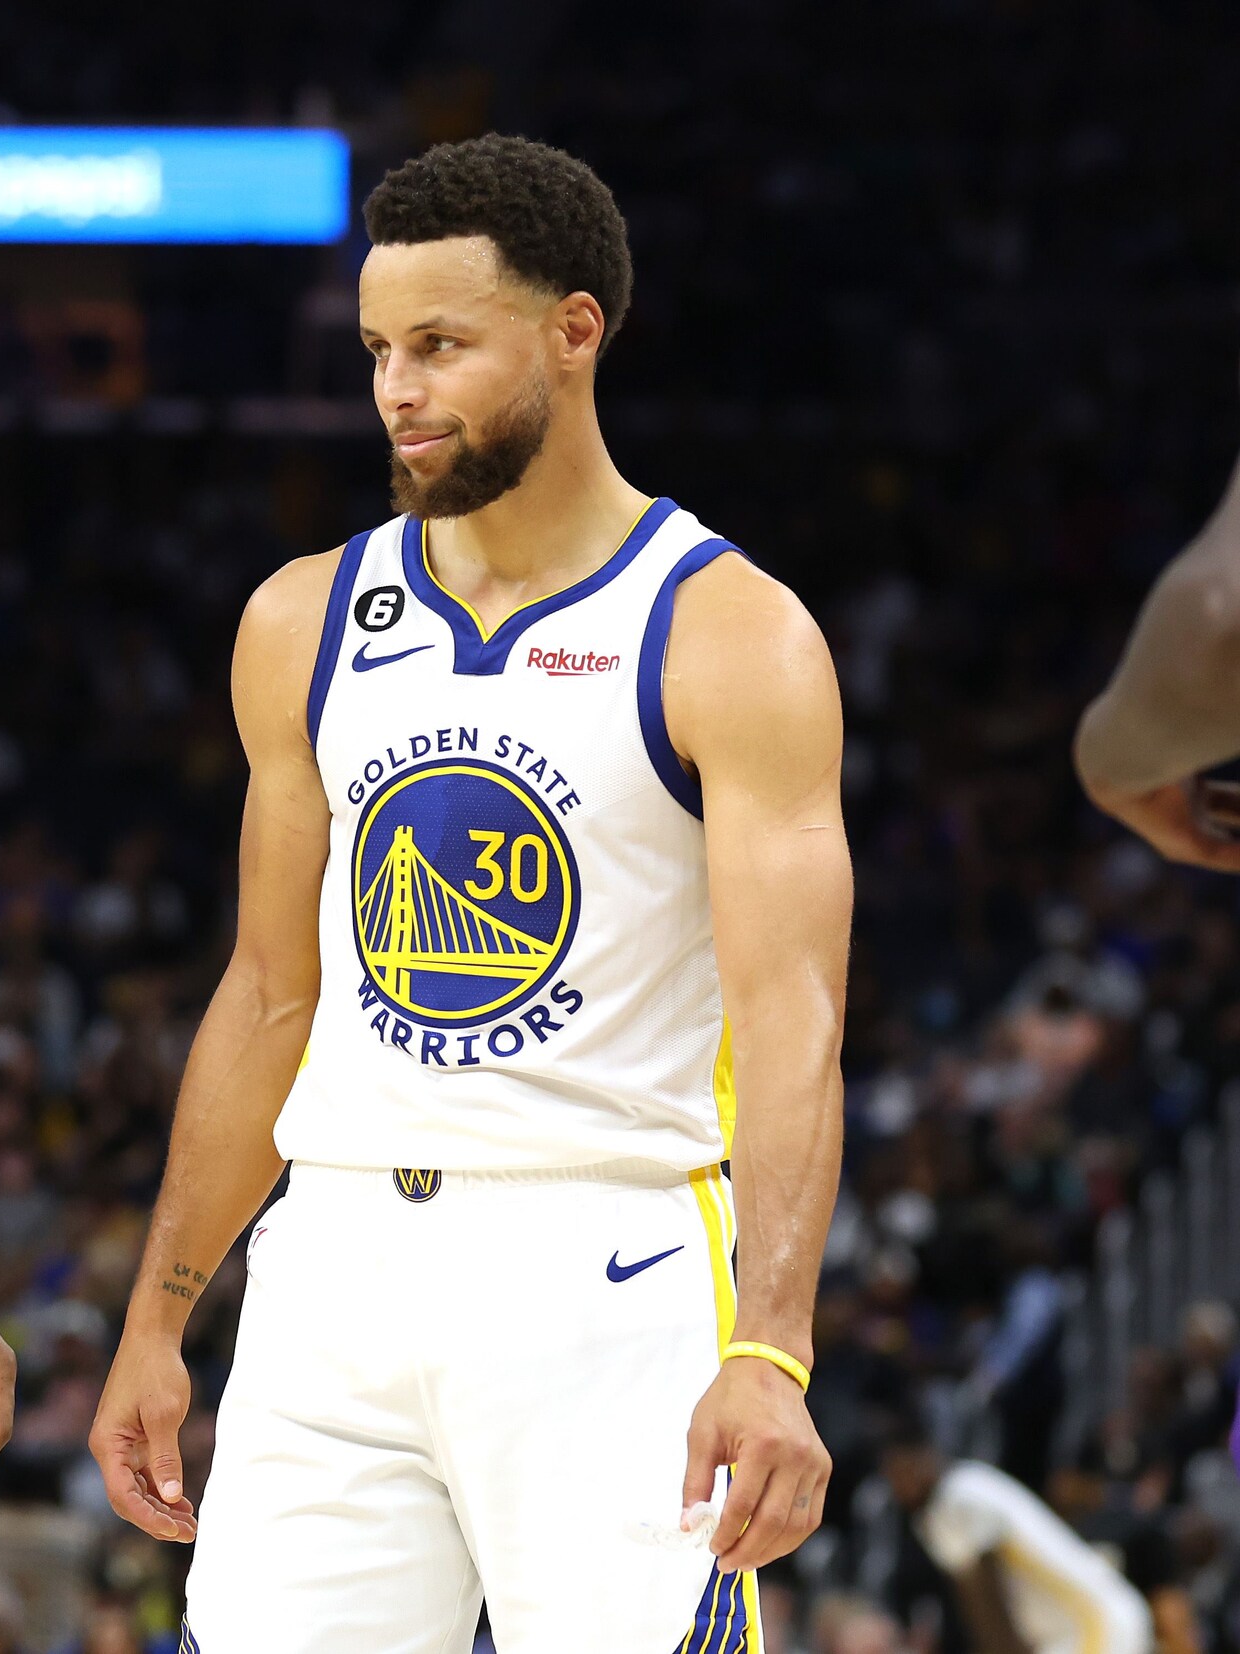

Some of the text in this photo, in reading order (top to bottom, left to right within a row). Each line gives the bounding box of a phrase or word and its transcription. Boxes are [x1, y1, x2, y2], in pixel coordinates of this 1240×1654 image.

[363, 591, 398, 627] 6
[526, 647, 621, 674] Rakuten
[347, 726, 582, 817] GOLDEN STATE
[463, 828, 549, 904] 30
[357, 973, 584, 1067] WARRIORS
